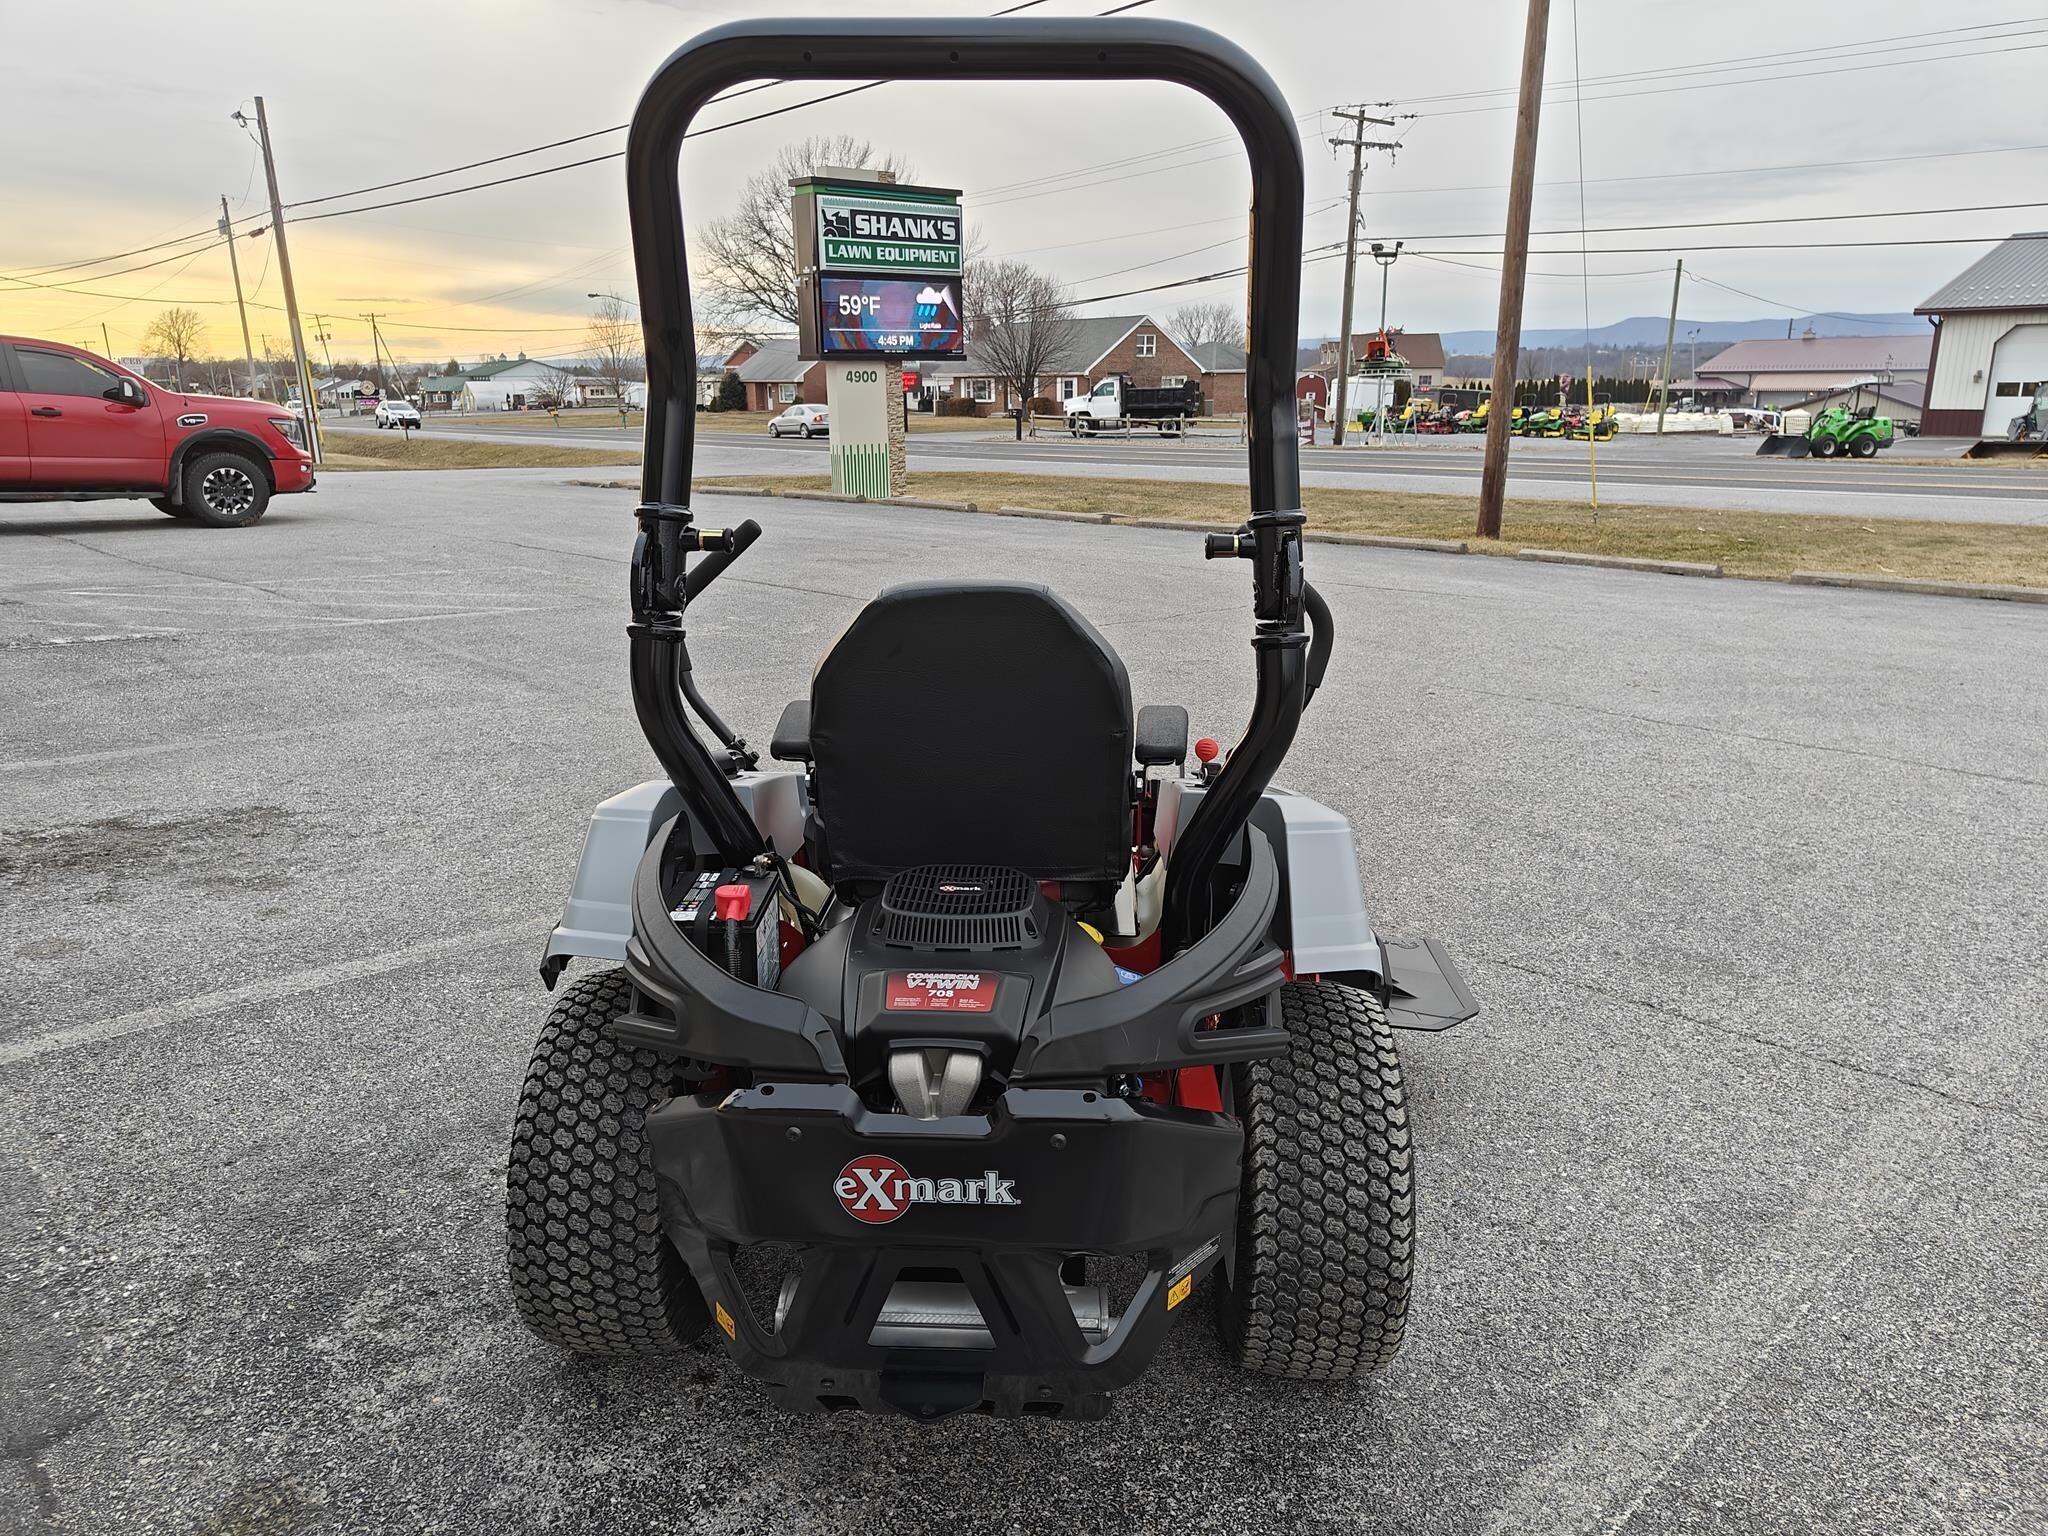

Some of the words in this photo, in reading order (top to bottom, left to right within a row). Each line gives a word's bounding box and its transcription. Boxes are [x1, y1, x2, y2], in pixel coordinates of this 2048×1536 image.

[855, 214, 956, 241] SHANK'S
[828, 244, 872, 260] LAWN
[877, 247, 957, 264] EQUIPMENT
[878, 335, 898, 346] 4:45
[899, 336, 914, 346] PM
[846, 370, 877, 383] 4900
[906, 972, 980, 981] COMMERCIAL
[906, 978, 980, 990] V-TWIN
[927, 989, 954, 997] 708
